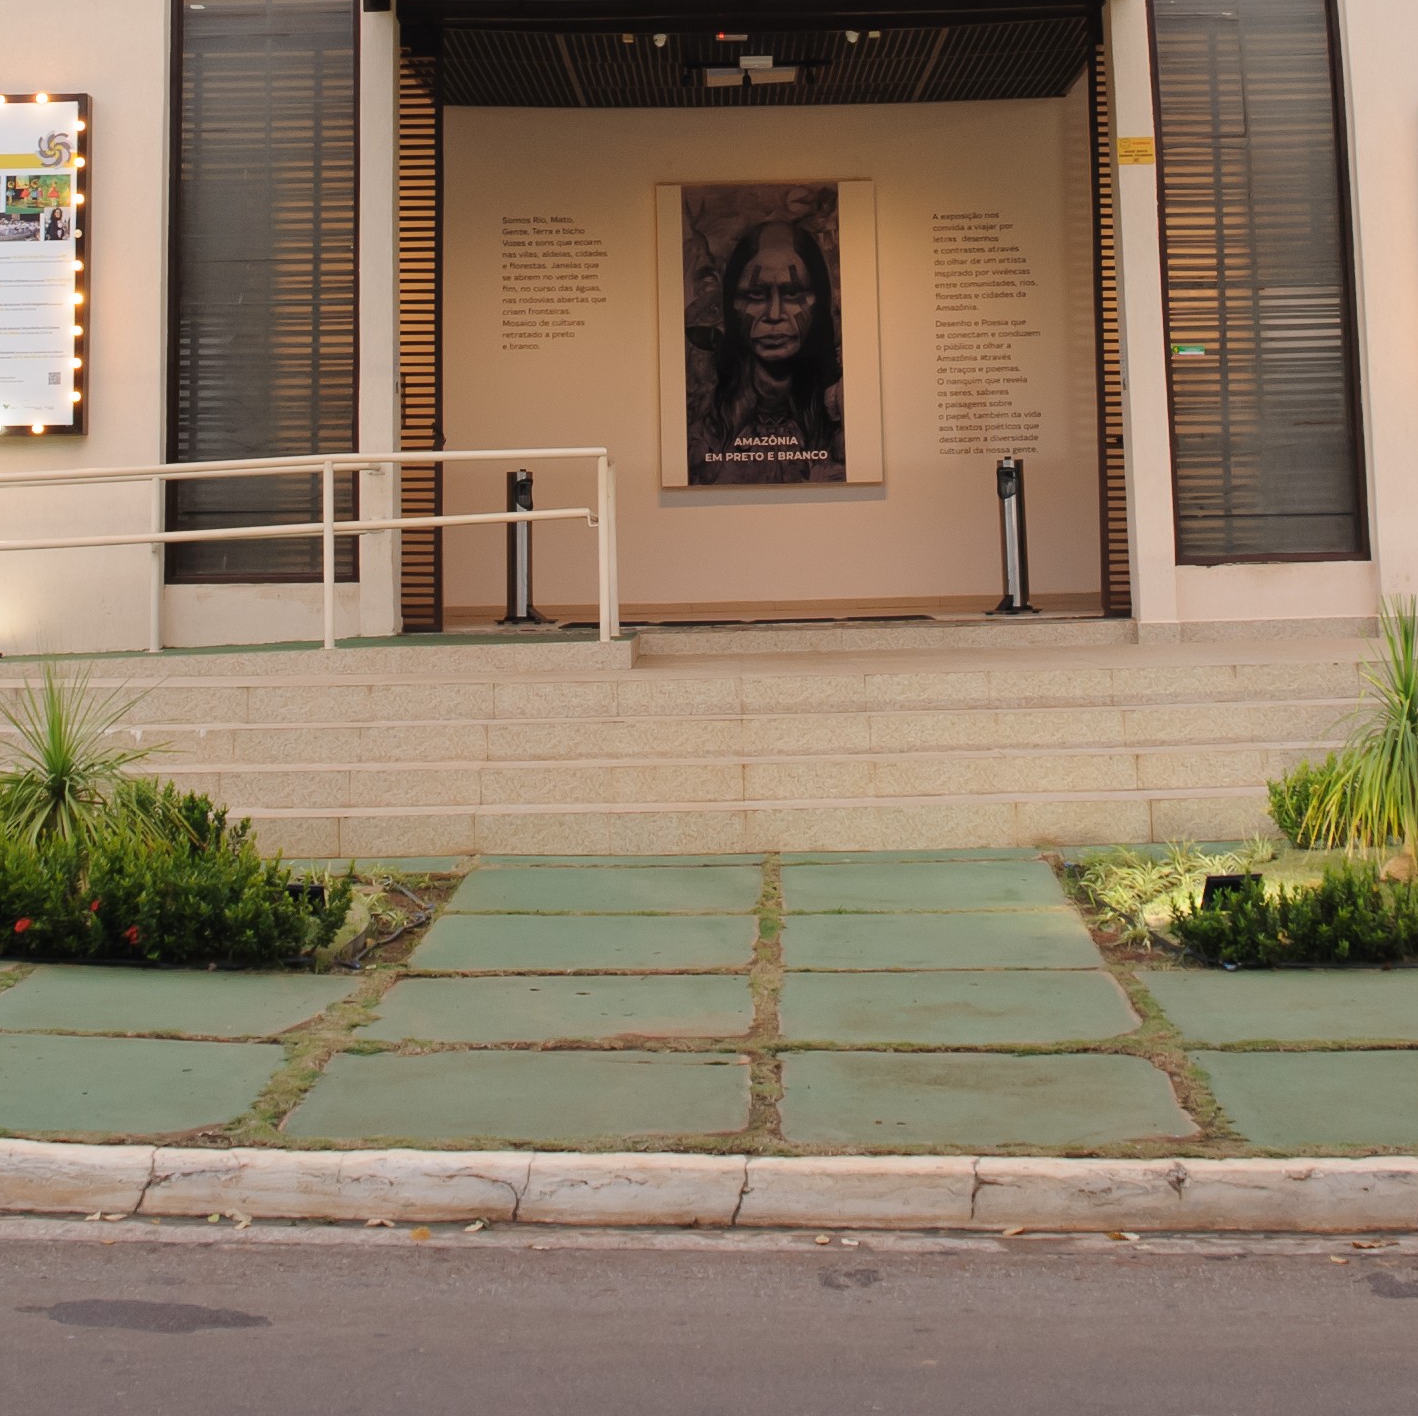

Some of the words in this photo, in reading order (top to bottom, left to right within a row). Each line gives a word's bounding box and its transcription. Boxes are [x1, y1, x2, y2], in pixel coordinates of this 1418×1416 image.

[734, 435, 798, 446] AMAZÔNIA
[705, 453, 722, 462] EM
[726, 452, 764, 461] PRETO
[768, 452, 774, 461] E
[778, 451, 828, 460] BRANCO
